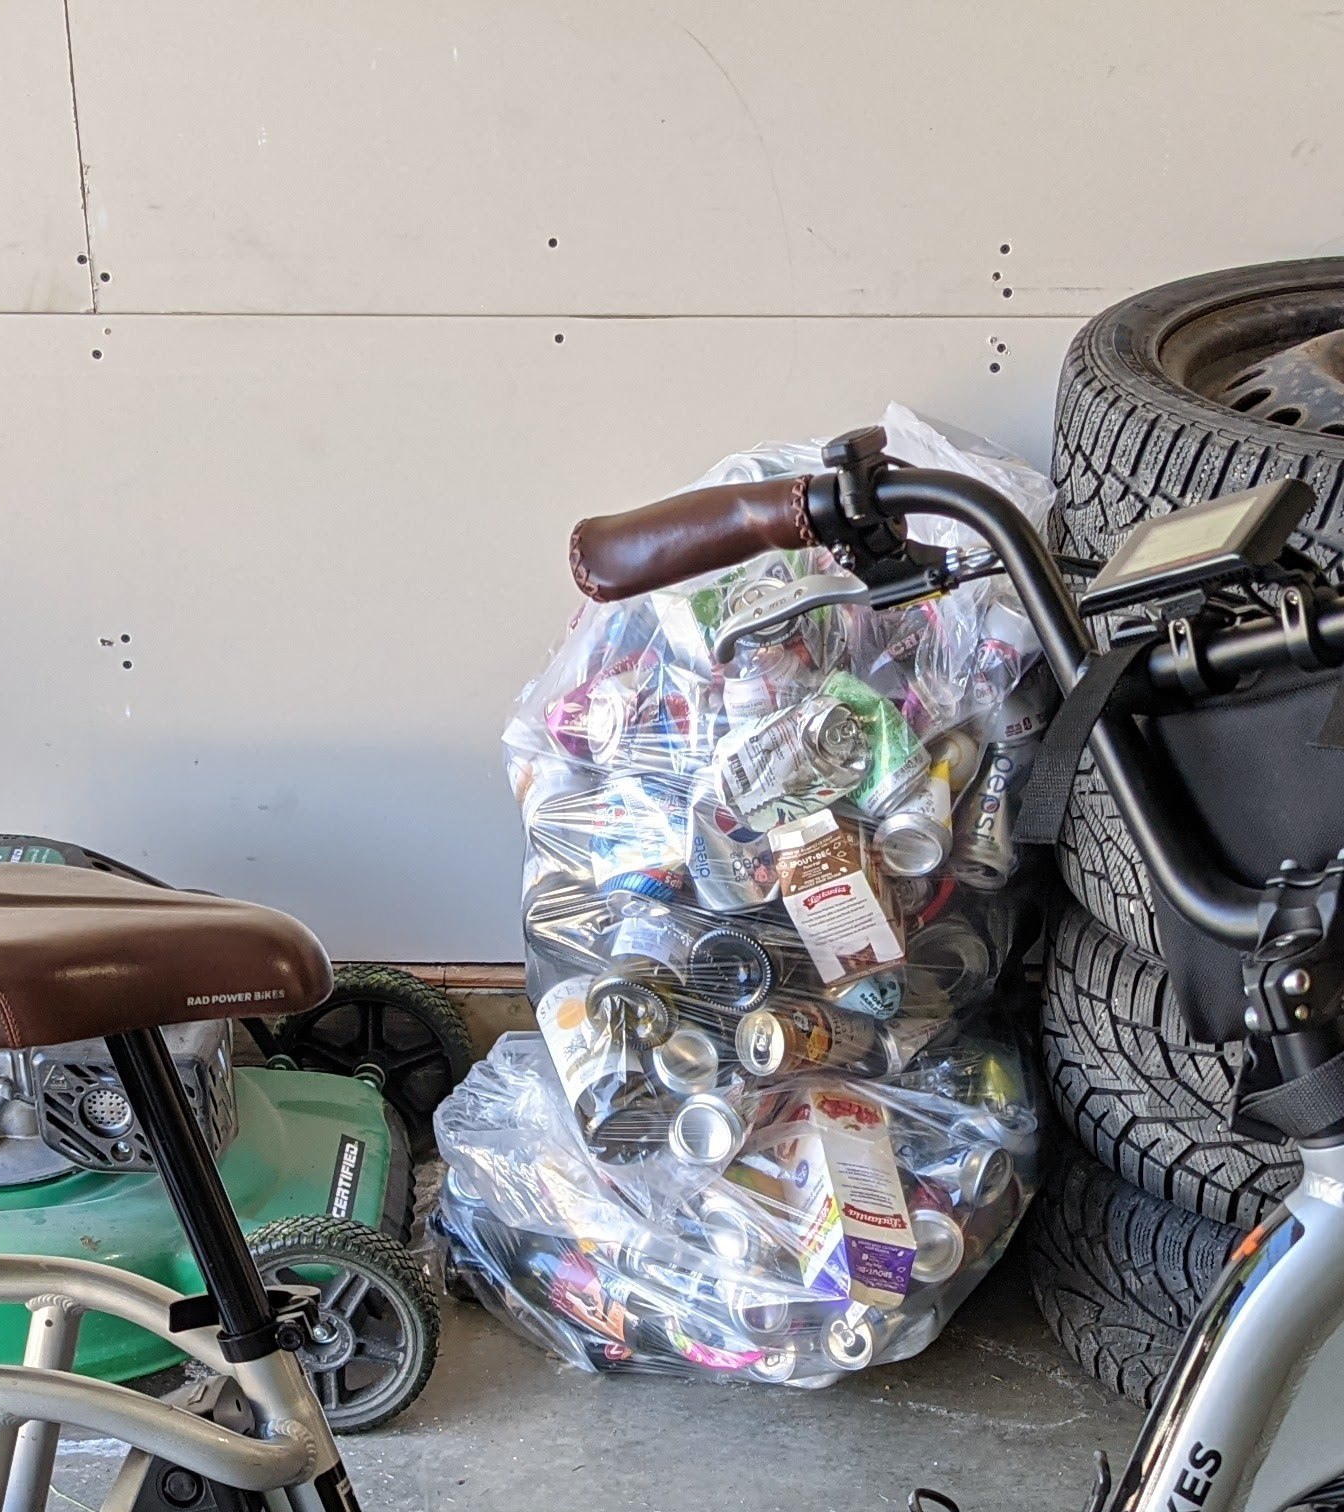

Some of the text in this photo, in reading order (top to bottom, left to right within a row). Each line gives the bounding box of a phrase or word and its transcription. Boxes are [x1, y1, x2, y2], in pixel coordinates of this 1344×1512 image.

[973, 755, 1014, 843] pepsi
[186, 989, 286, 1007] RAD POWER BIKES
[331, 1142, 359, 1219] CERTIFIED
